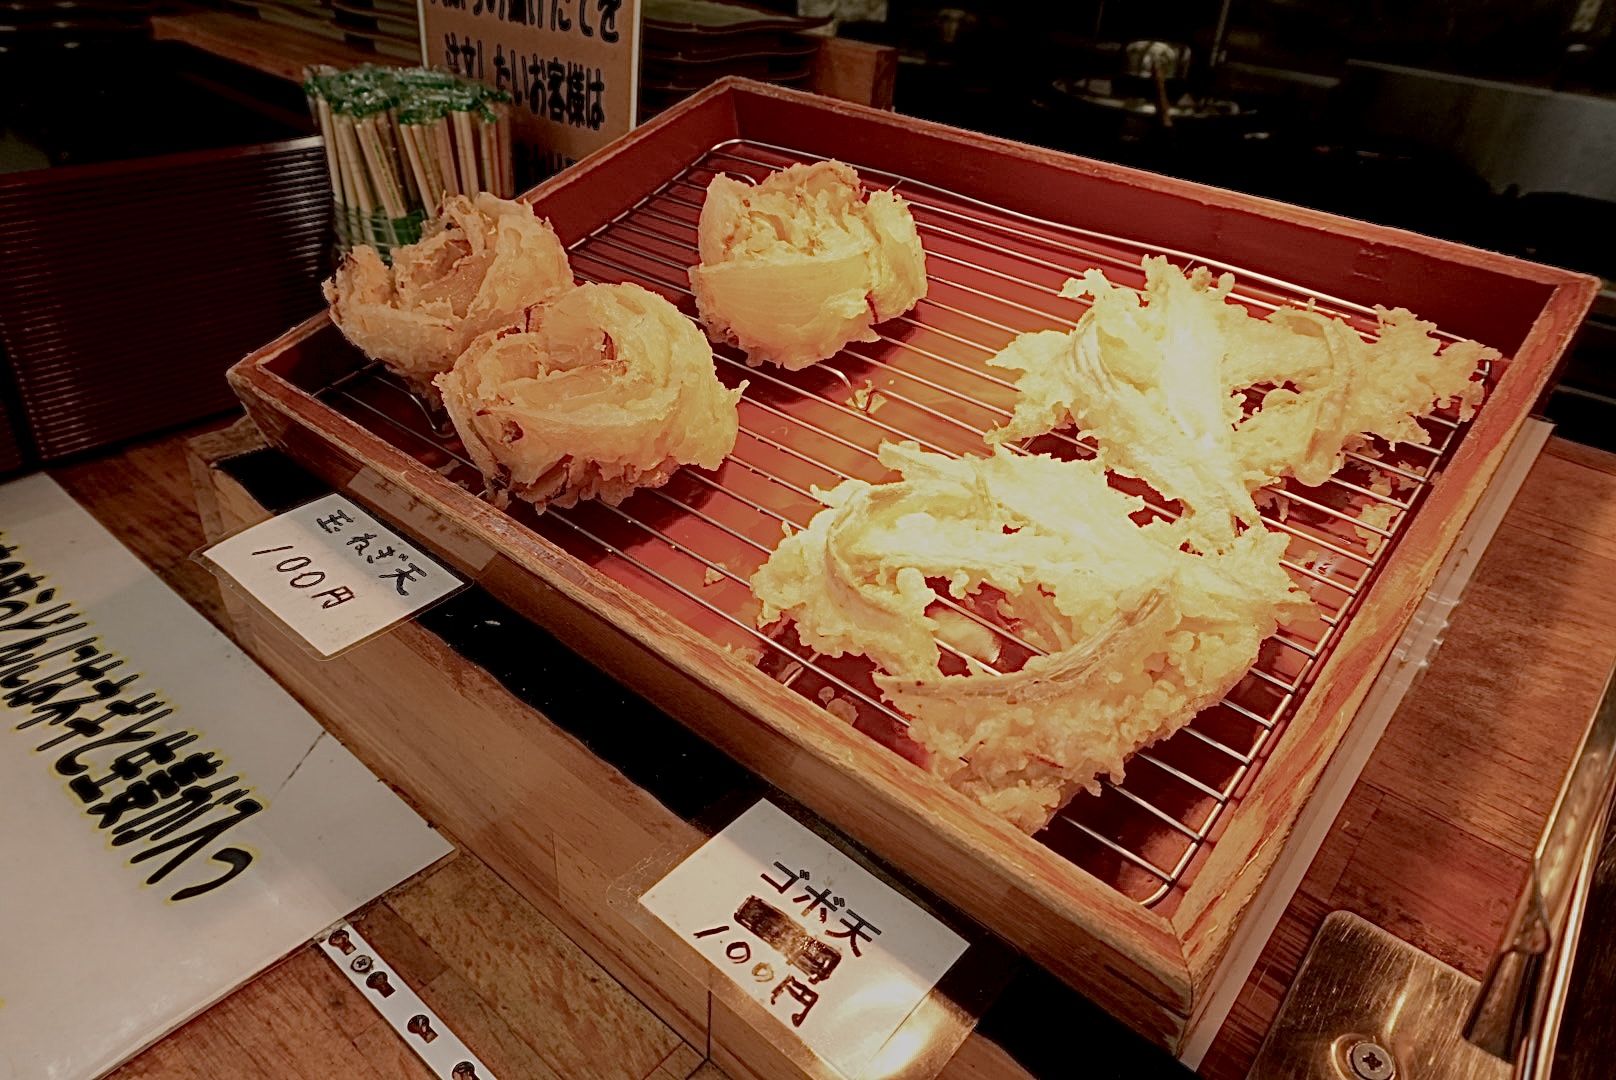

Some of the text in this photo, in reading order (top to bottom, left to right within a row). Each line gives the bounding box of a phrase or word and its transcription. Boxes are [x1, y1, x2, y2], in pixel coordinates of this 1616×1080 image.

[251, 545, 355, 610] 100円
[316, 509, 427, 596] 玉ねぎ天
[760, 861, 882, 958] ゴボ天
[693, 925, 819, 1028] 100円
